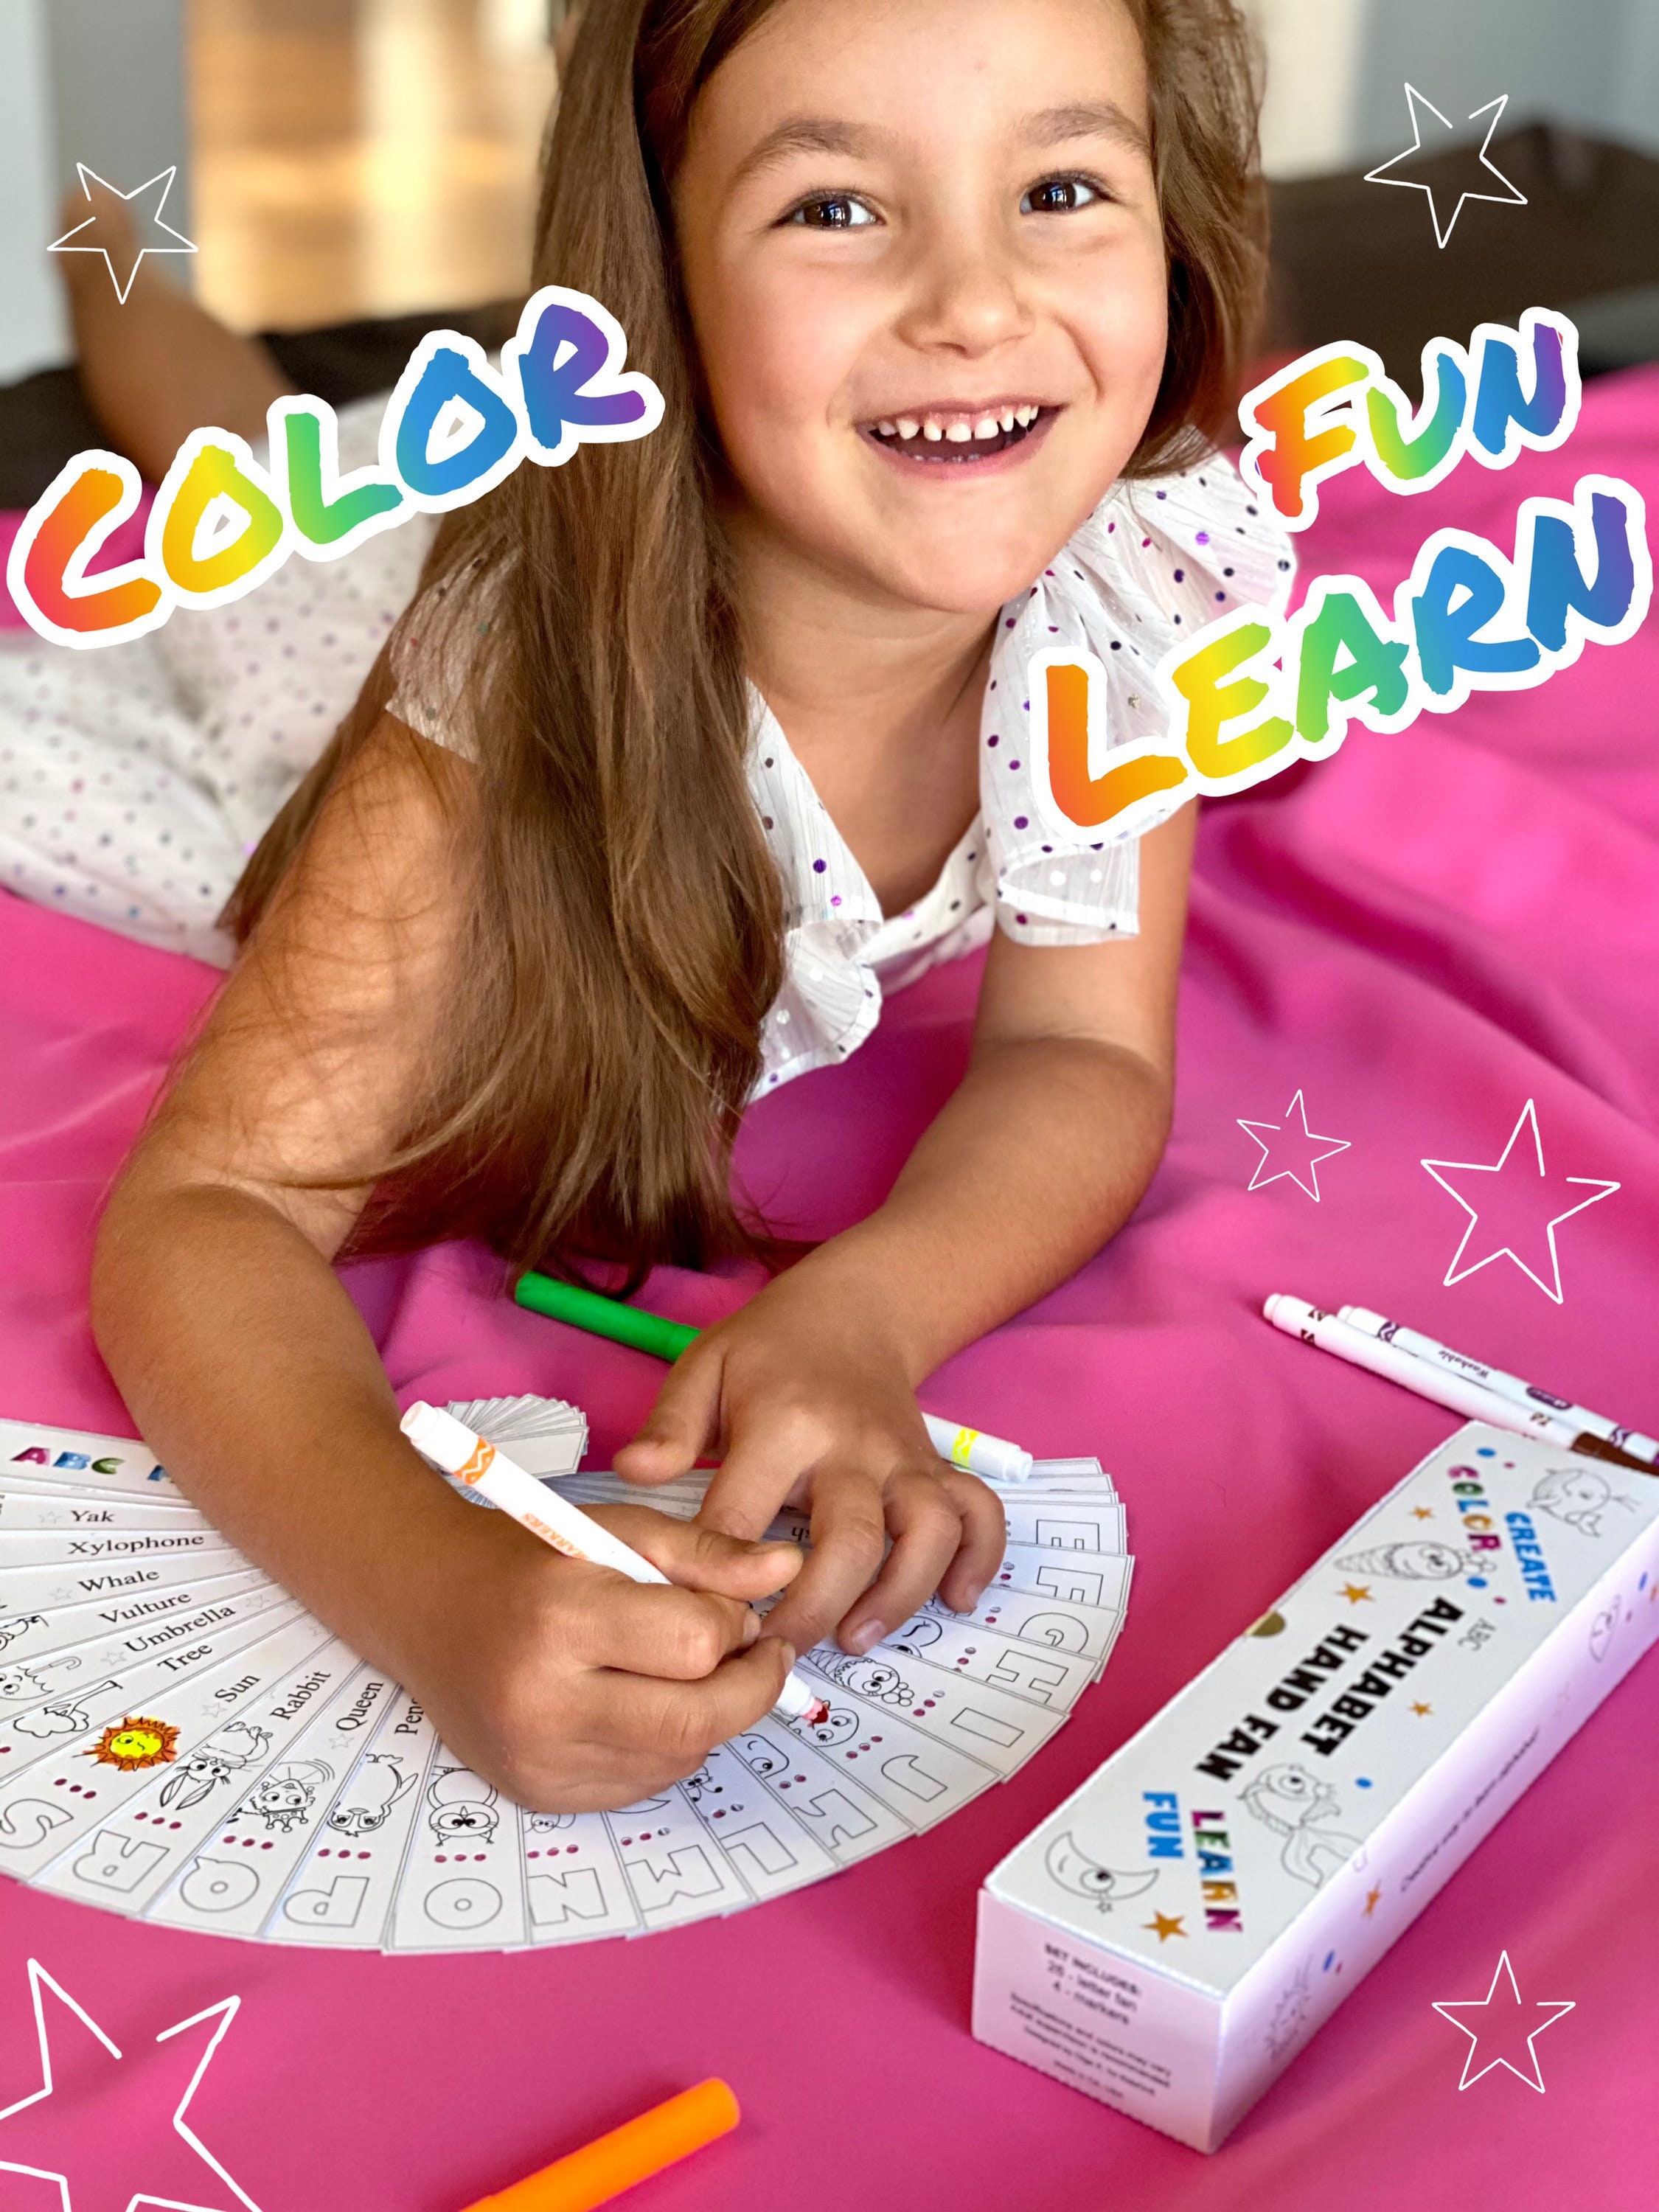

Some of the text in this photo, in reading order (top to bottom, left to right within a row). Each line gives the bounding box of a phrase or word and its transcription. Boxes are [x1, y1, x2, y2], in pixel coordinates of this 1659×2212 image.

[1438, 1350, 1489, 1380] Washable
[10, 1446, 125, 1475] ABC
[71, 1509, 116, 1523] Yak
[1448, 1464, 1501, 1553] COLOR
[67, 1534, 205, 1556] Xylophone
[1504, 1512, 1557, 1602] CREATE
[77, 1569, 161, 1593] Whale
[98, 1593, 192, 1624] Vulture
[122, 1604, 237, 1655] Umbrella
[156, 1643, 212, 1673] Tree
[1299, 1596, 1465, 1757] ALPHABET
[214, 1673, 261, 1703] Sun
[268, 1669, 332, 1720] Rabbit
[335, 1680, 384, 1731] Queen
[1193, 1624, 1371, 1782] HAND FAN
[1142, 1791, 1184, 1859] FUN
[1191, 1809, 1243, 1933] LEARN
